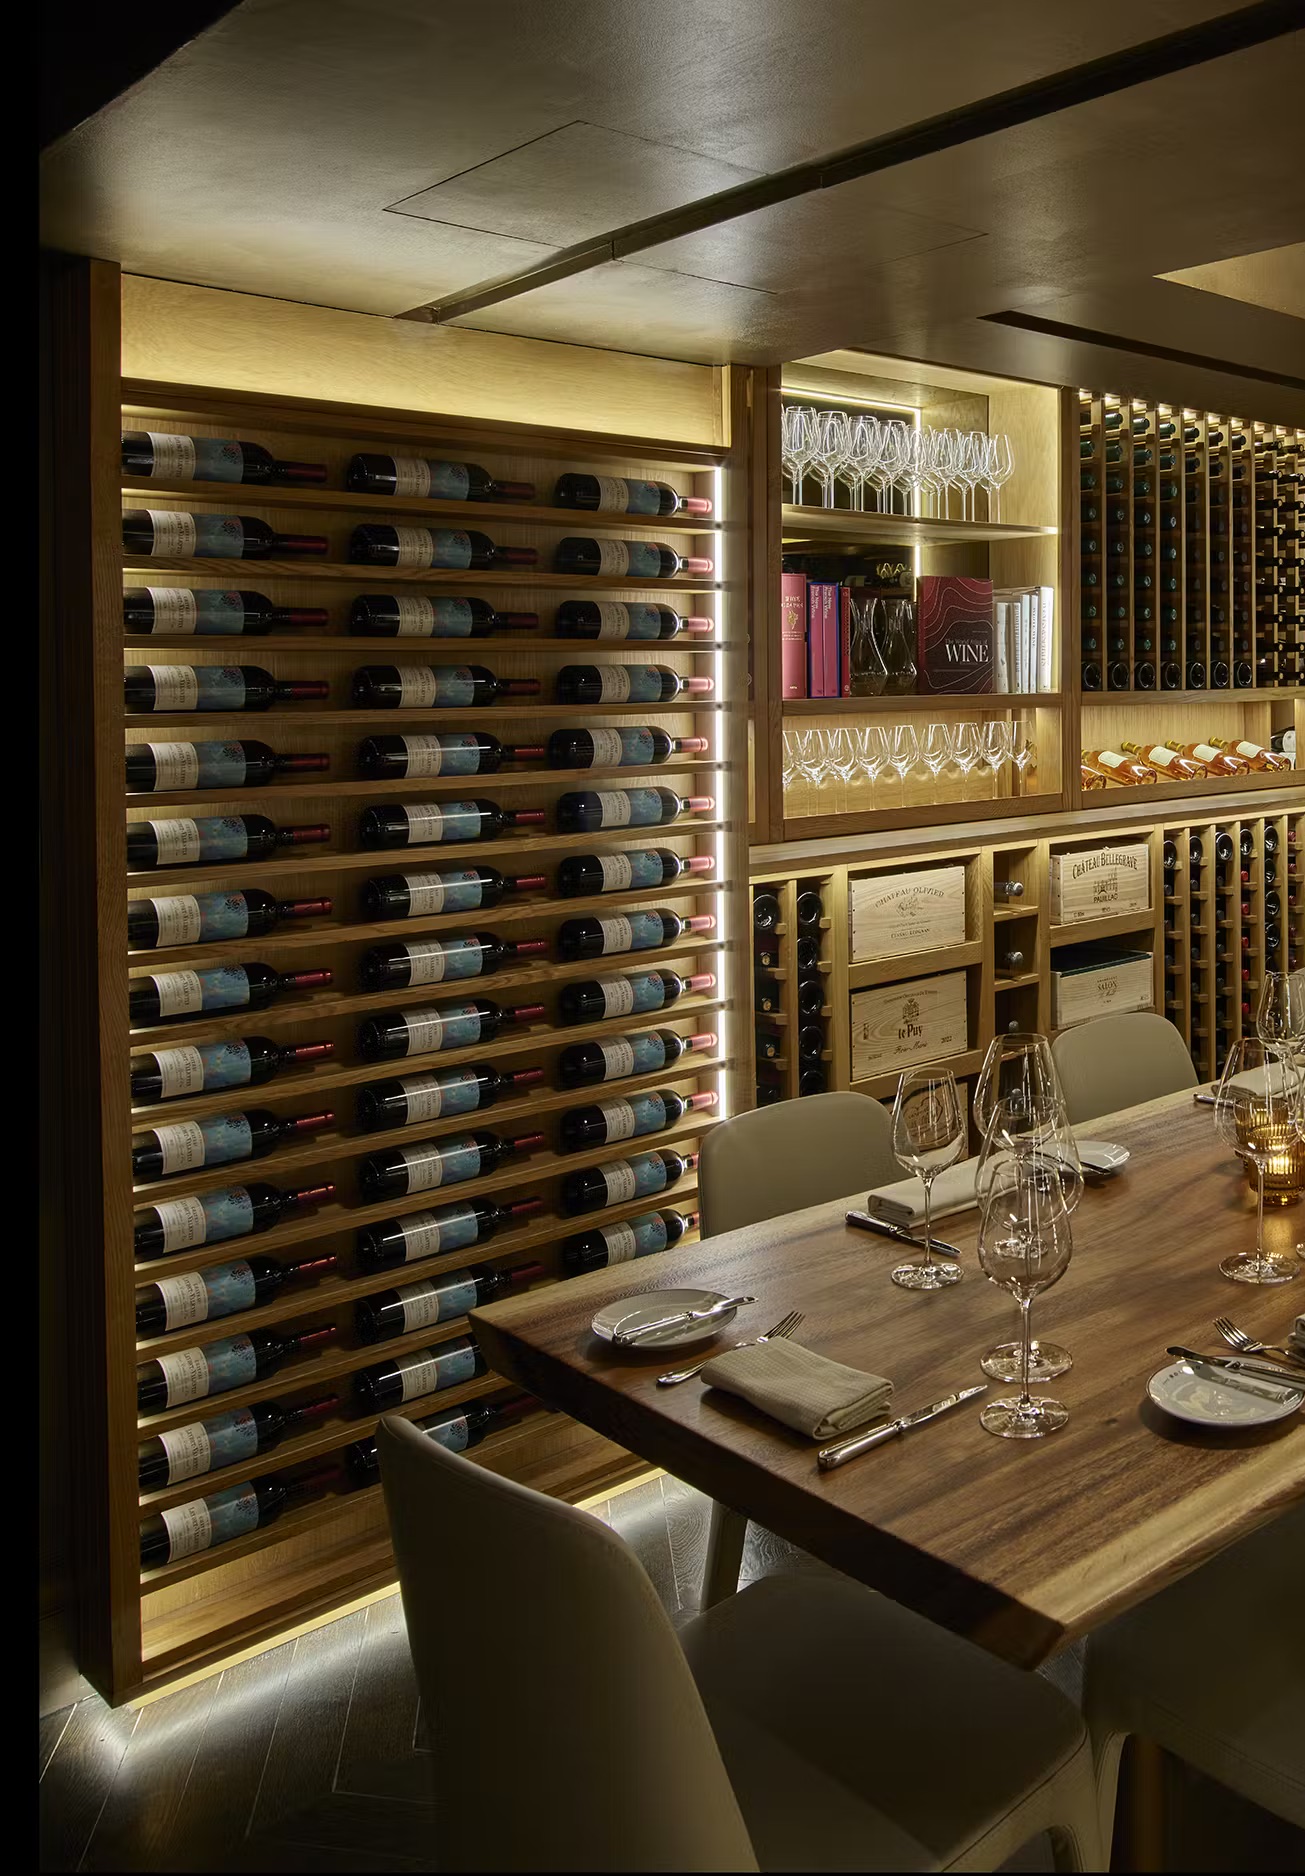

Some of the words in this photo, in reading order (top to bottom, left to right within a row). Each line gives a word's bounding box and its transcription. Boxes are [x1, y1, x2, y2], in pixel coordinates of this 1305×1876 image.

[945, 644, 989, 662] WINE
[1100, 852, 1138, 870] BELLEGRAVE
[1093, 893, 1118, 904] PAUILLAC
[907, 1023, 924, 1038] Puy
